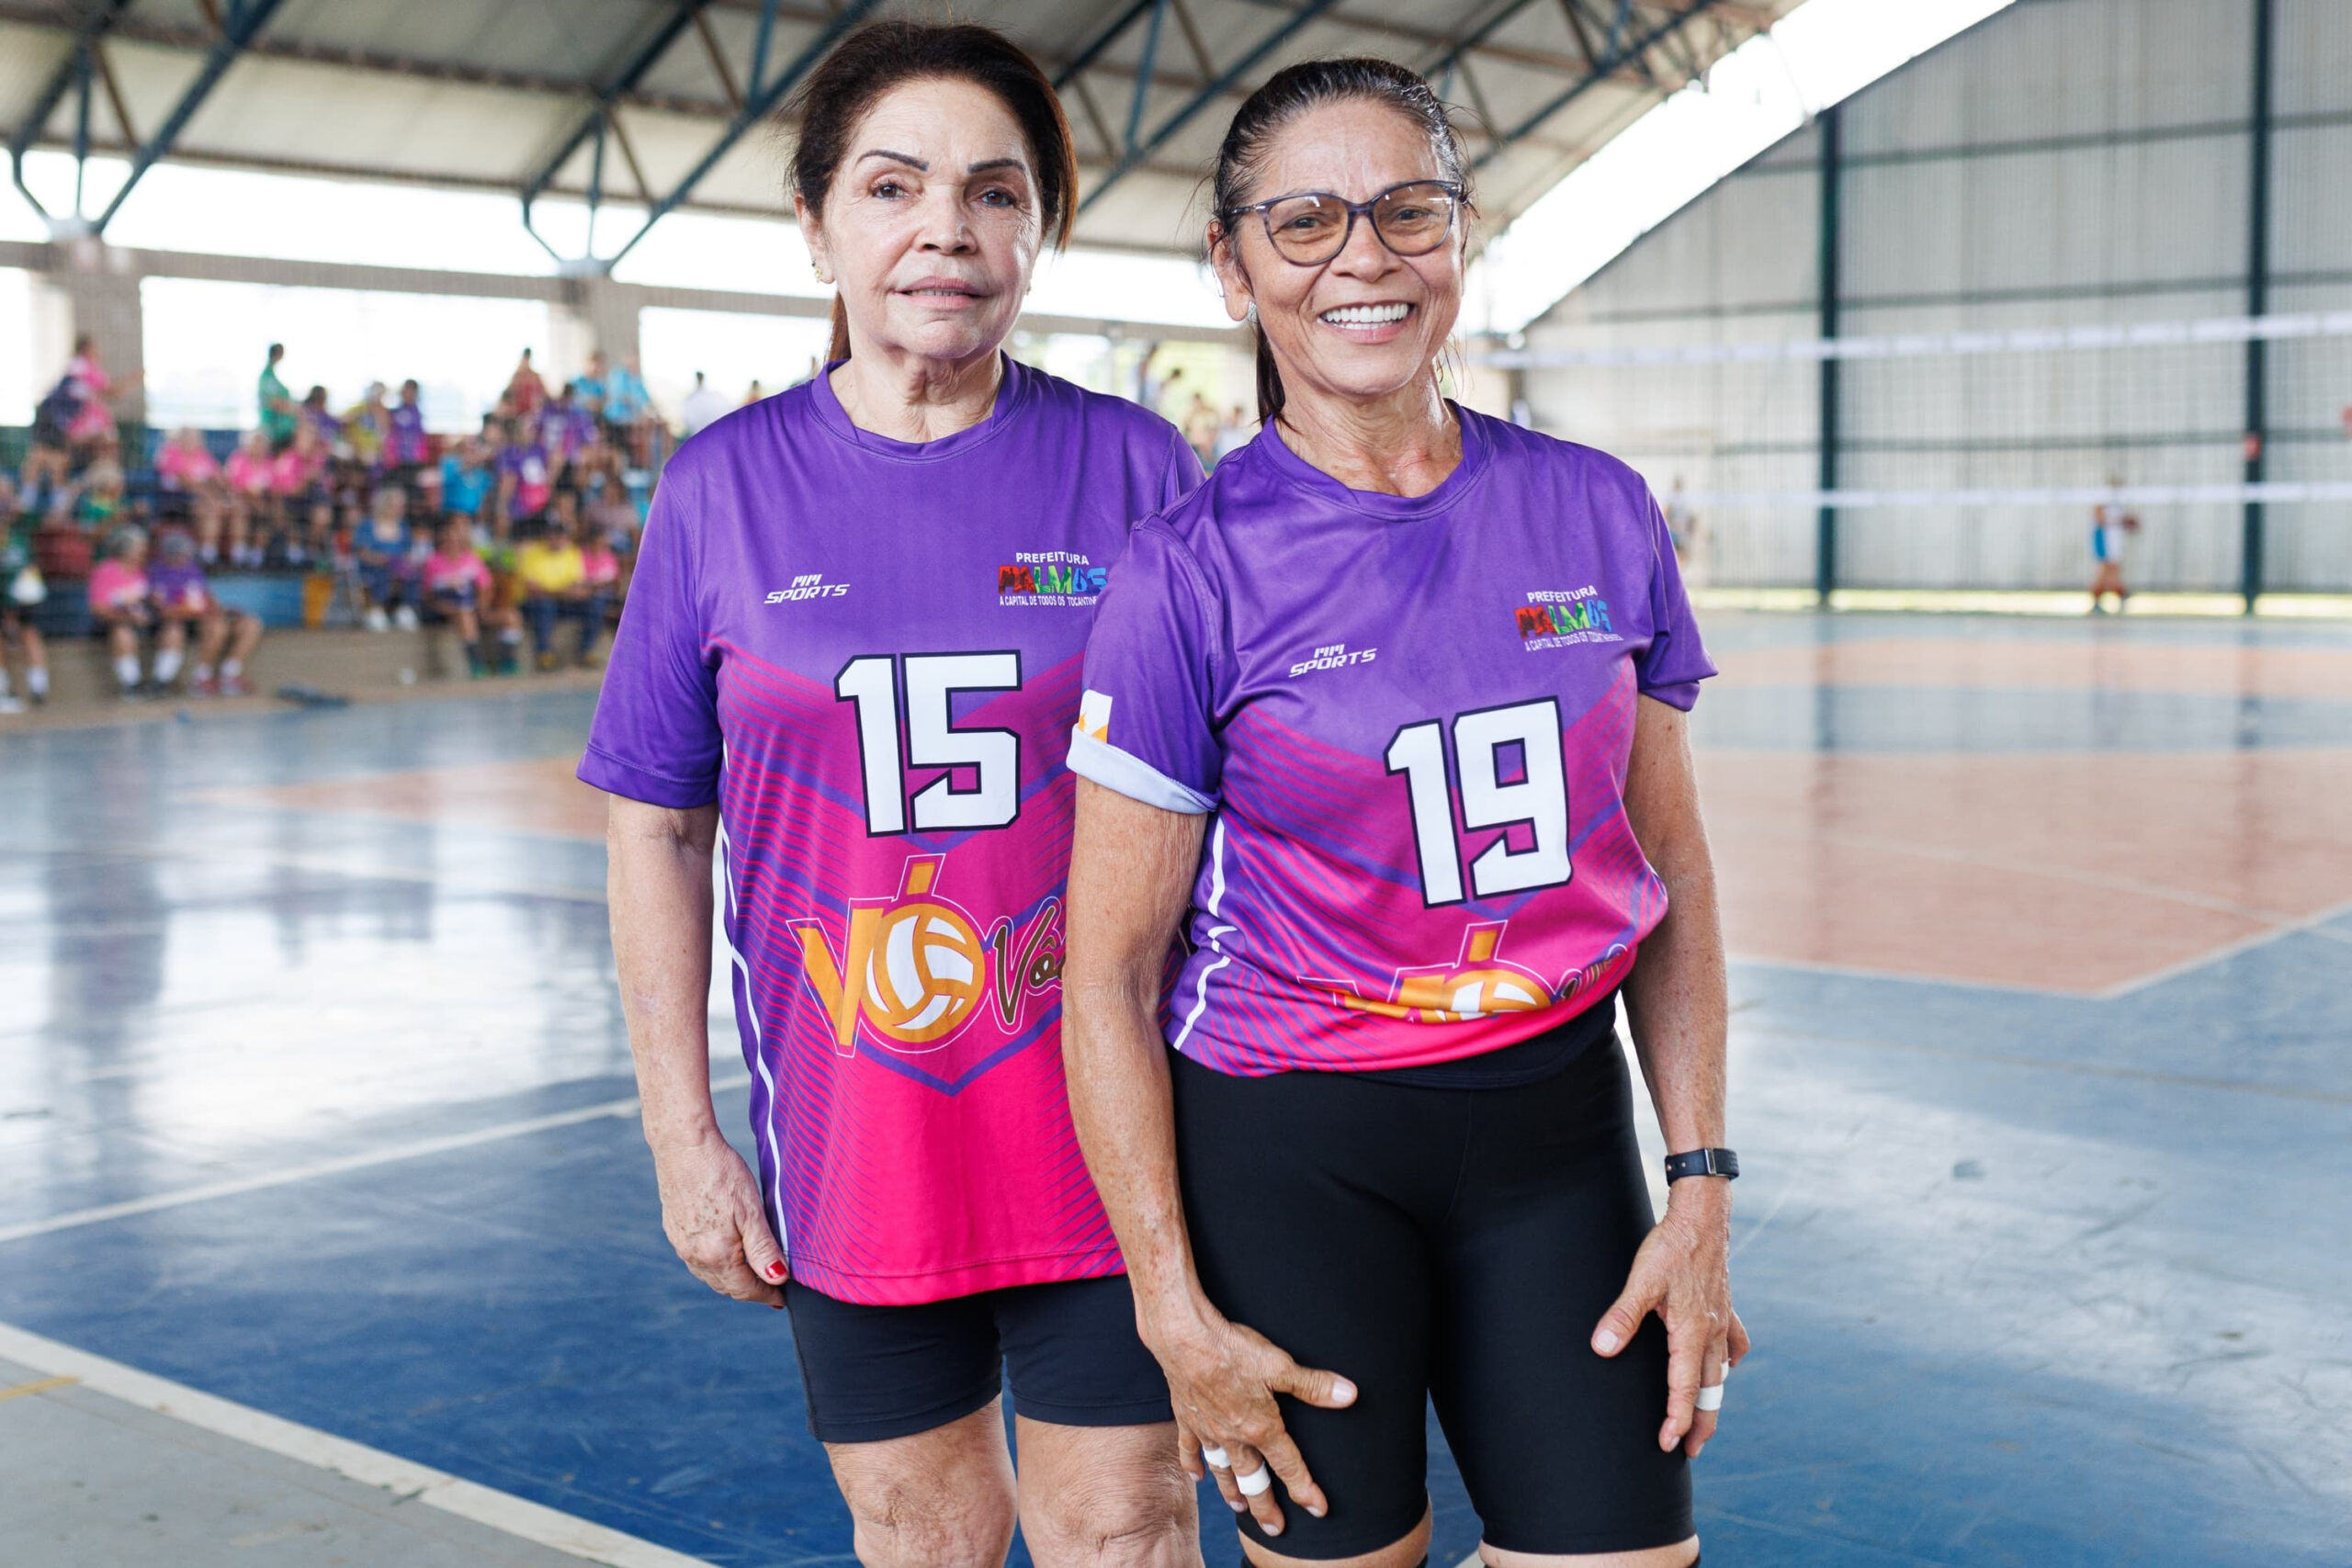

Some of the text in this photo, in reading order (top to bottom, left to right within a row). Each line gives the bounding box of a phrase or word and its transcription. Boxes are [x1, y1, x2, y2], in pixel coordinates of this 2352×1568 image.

[1015, 551, 1090, 566] PREFEITURA
[791, 573, 822, 588] MM
[998, 565, 1108, 594] PALMAS
[763, 583, 851, 604] SPORTS
[1000, 596, 1004, 605] A
[1004, 596, 1029, 606] CAPITAL
[1029, 596, 1037, 606] DE
[1037, 596, 1057, 606] TODOS
[1057, 596, 1066, 606] OS
[1526, 585, 1598, 603] PREFEITURA
[1514, 599, 1611, 640] PALMAS
[1288, 648, 1377, 678] SPORTS
[1314, 644, 1345, 659] MM
[834, 649, 1023, 838] 15
[1383, 695, 1574, 909] 19
[993, 905, 1067, 1025] Vô
